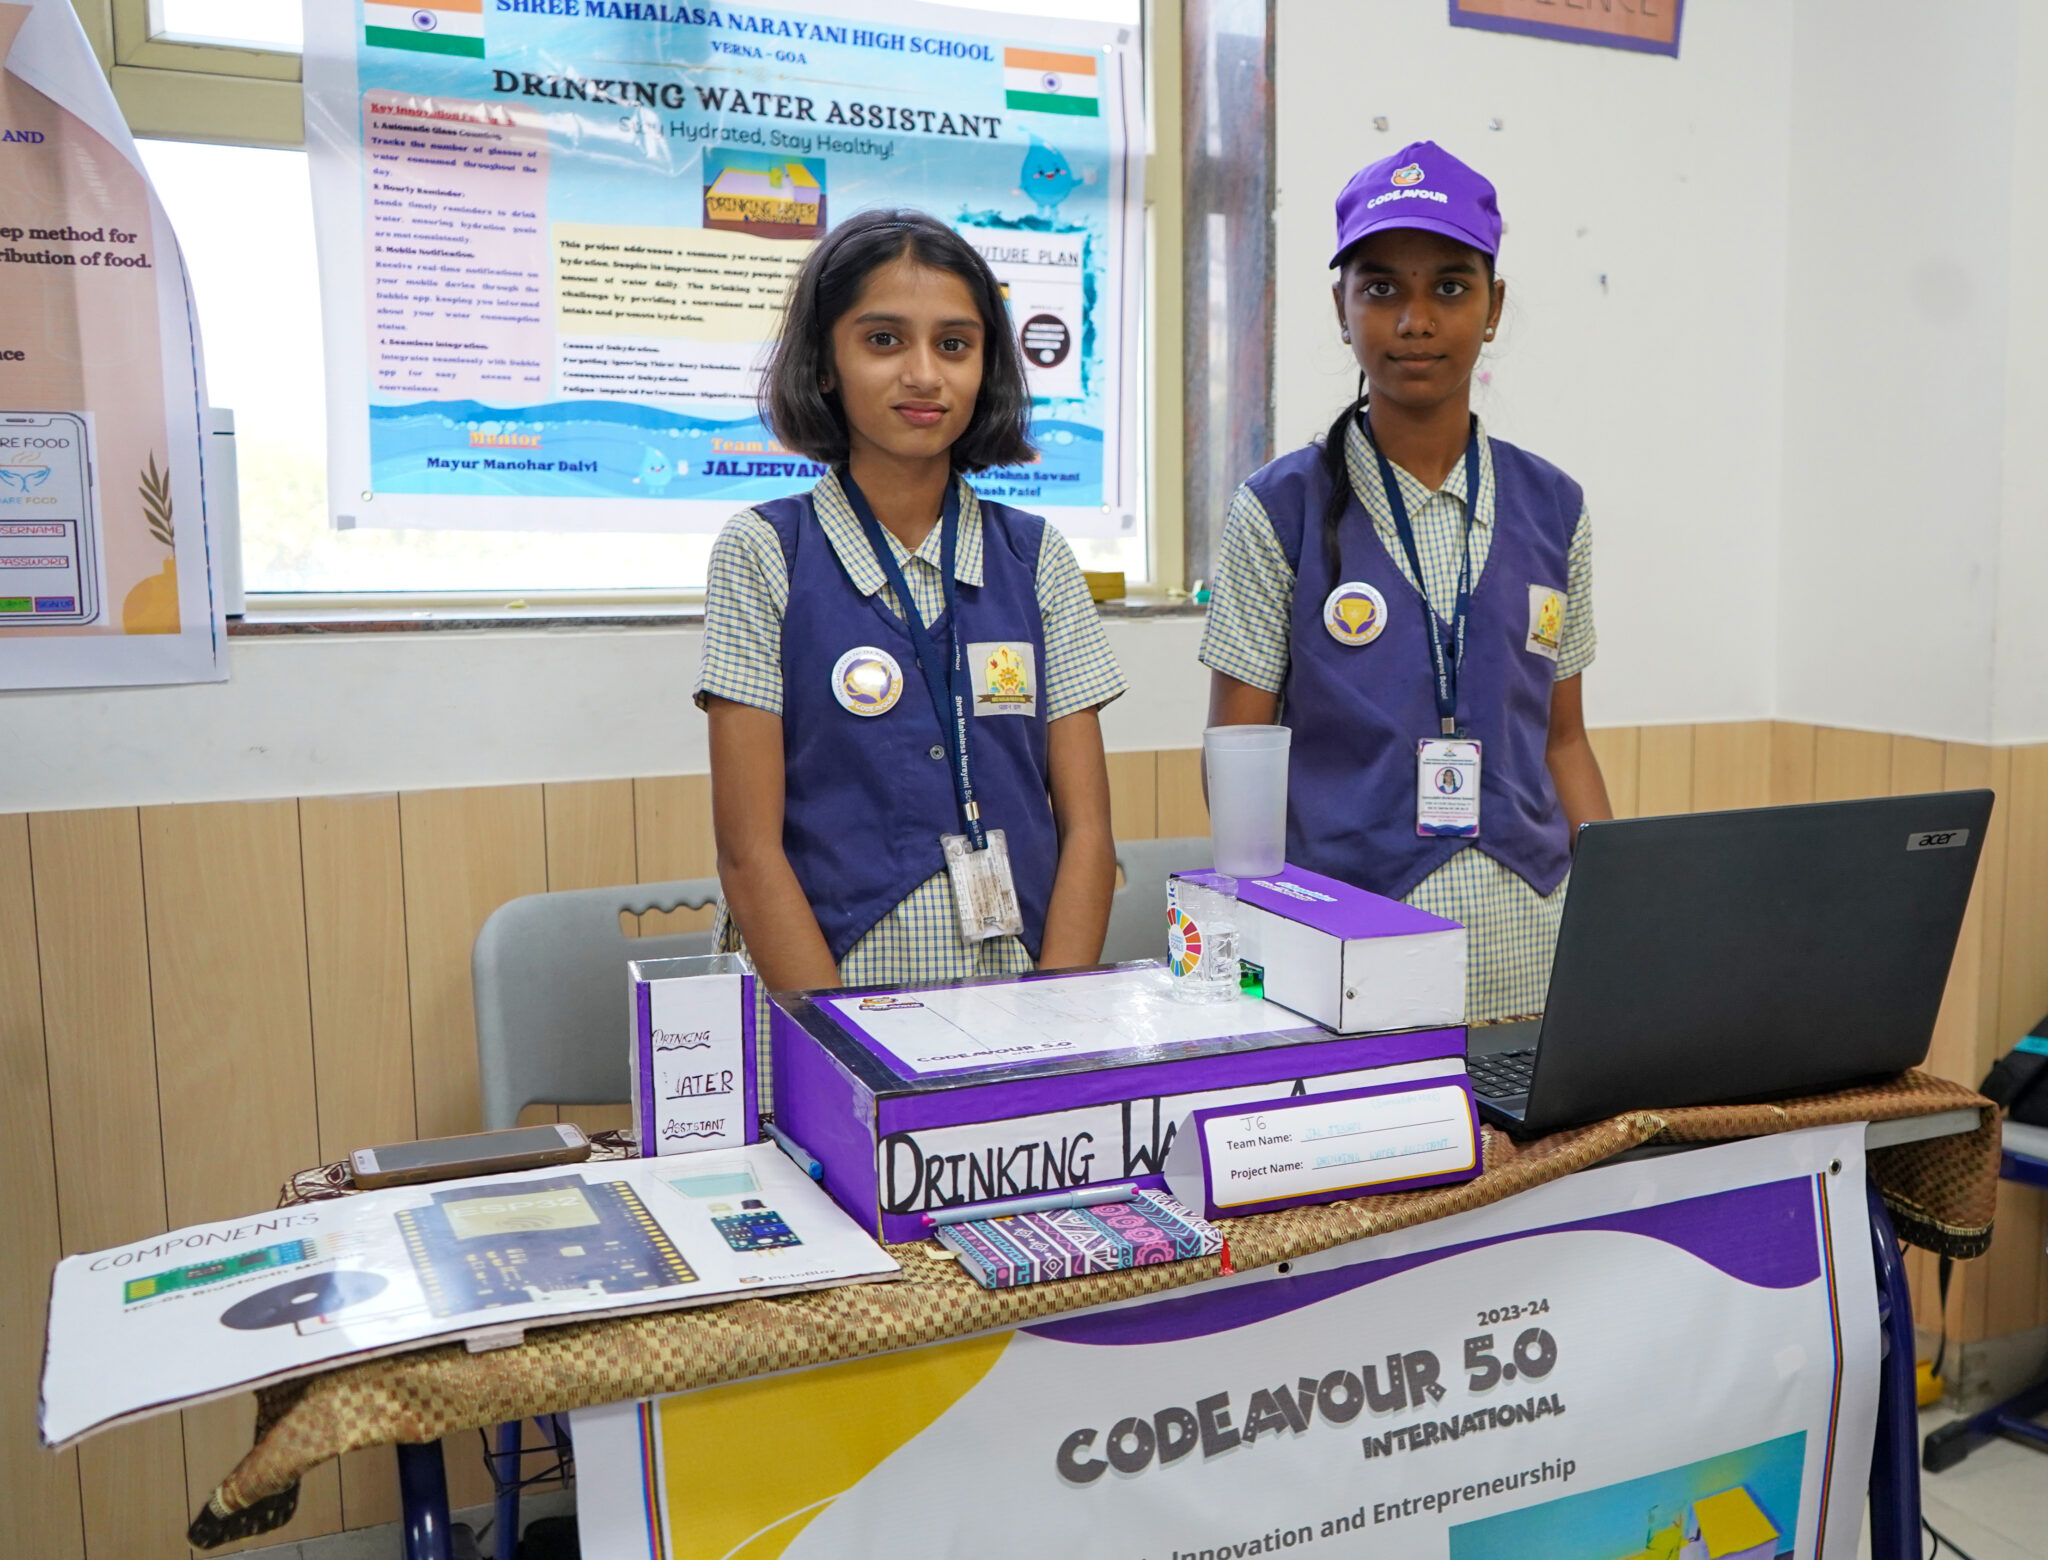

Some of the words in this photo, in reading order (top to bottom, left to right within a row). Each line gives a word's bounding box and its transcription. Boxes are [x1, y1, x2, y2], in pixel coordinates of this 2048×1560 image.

[497, 0, 580, 16] SHREE
[585, 1, 721, 27] MAHALASA
[728, 15, 847, 46] NARAYANI
[853, 30, 905, 53] HIGH
[910, 37, 995, 62] SCHOOL
[712, 40, 763, 58] VERNA
[775, 50, 807, 65] GOA
[494, 70, 685, 109] DRINKING
[696, 86, 815, 120] WATER
[828, 101, 1002, 138] ASSISTANT
[3, 130, 45, 144] AND
[381, 122, 430, 133] Automatic
[432, 127, 457, 135] Glass
[371, 137, 405, 146] Tracks
[410, 139, 425, 148] the
[430, 143, 468, 152] number
[671, 120, 766, 146] Hydrated,
[771, 129, 812, 153] Stay
[818, 136, 894, 158] Healthy!
[1367, 189, 1448, 209] CODEAVOUR
[29, 227, 105, 242] method
[109, 229, 137, 244] for
[560, 241, 581, 249] This
[585, 243, 620, 253] project
[974, 246, 1029, 263] UTURE
[1039, 248, 1079, 264] PLAN
[81, 252, 100, 266] of
[104, 253, 152, 268] food.
[24, 438, 69, 449] FOOD
[470, 431, 542, 447] Mentor
[712, 438, 762, 452] Team
[427, 457, 479, 472] Mayur
[484, 458, 554, 472] Manohar
[559, 460, 599, 472] Dalvi
[1034, 472, 1080, 481] Sawant
[1010, 487, 1041, 496] Patel
[0, 526, 63, 534] SERNAME
[1439, 673, 1448, 700] School
[955, 696, 963, 717] Shree
[957, 718, 966, 753] Mahalasa
[961, 753, 971, 789] Narayani
[1919, 833, 1957, 846] acer
[652, 1029, 711, 1043] DRINKING
[917, 1045, 1034, 1062] CODEAVOUR
[663, 1070, 734, 1096] ATER
[663, 1118, 725, 1135] ASSISTANT
[1227, 1140, 1256, 1151] Team
[1258, 1133, 1293, 1145] Name:
[879, 1131, 1095, 1214] DRINKING
[1230, 1165, 1267, 1180] Project
[1270, 1161, 1304, 1174] Name:
[452, 1195, 583, 1219] ESP32
[89, 1213, 321, 1272] COMPONENTS
[1476, 1297, 1551, 1327] 2023-24
[1055, 1347, 1448, 1488] CODEAVOUR
[1463, 1327, 1558, 1392] 5.0
[1361, 1392, 1567, 1461] INTERNATIONAL
[1320, 1507, 1366, 1538] and
[1373, 1456, 1577, 1525] Entrepreneurship
